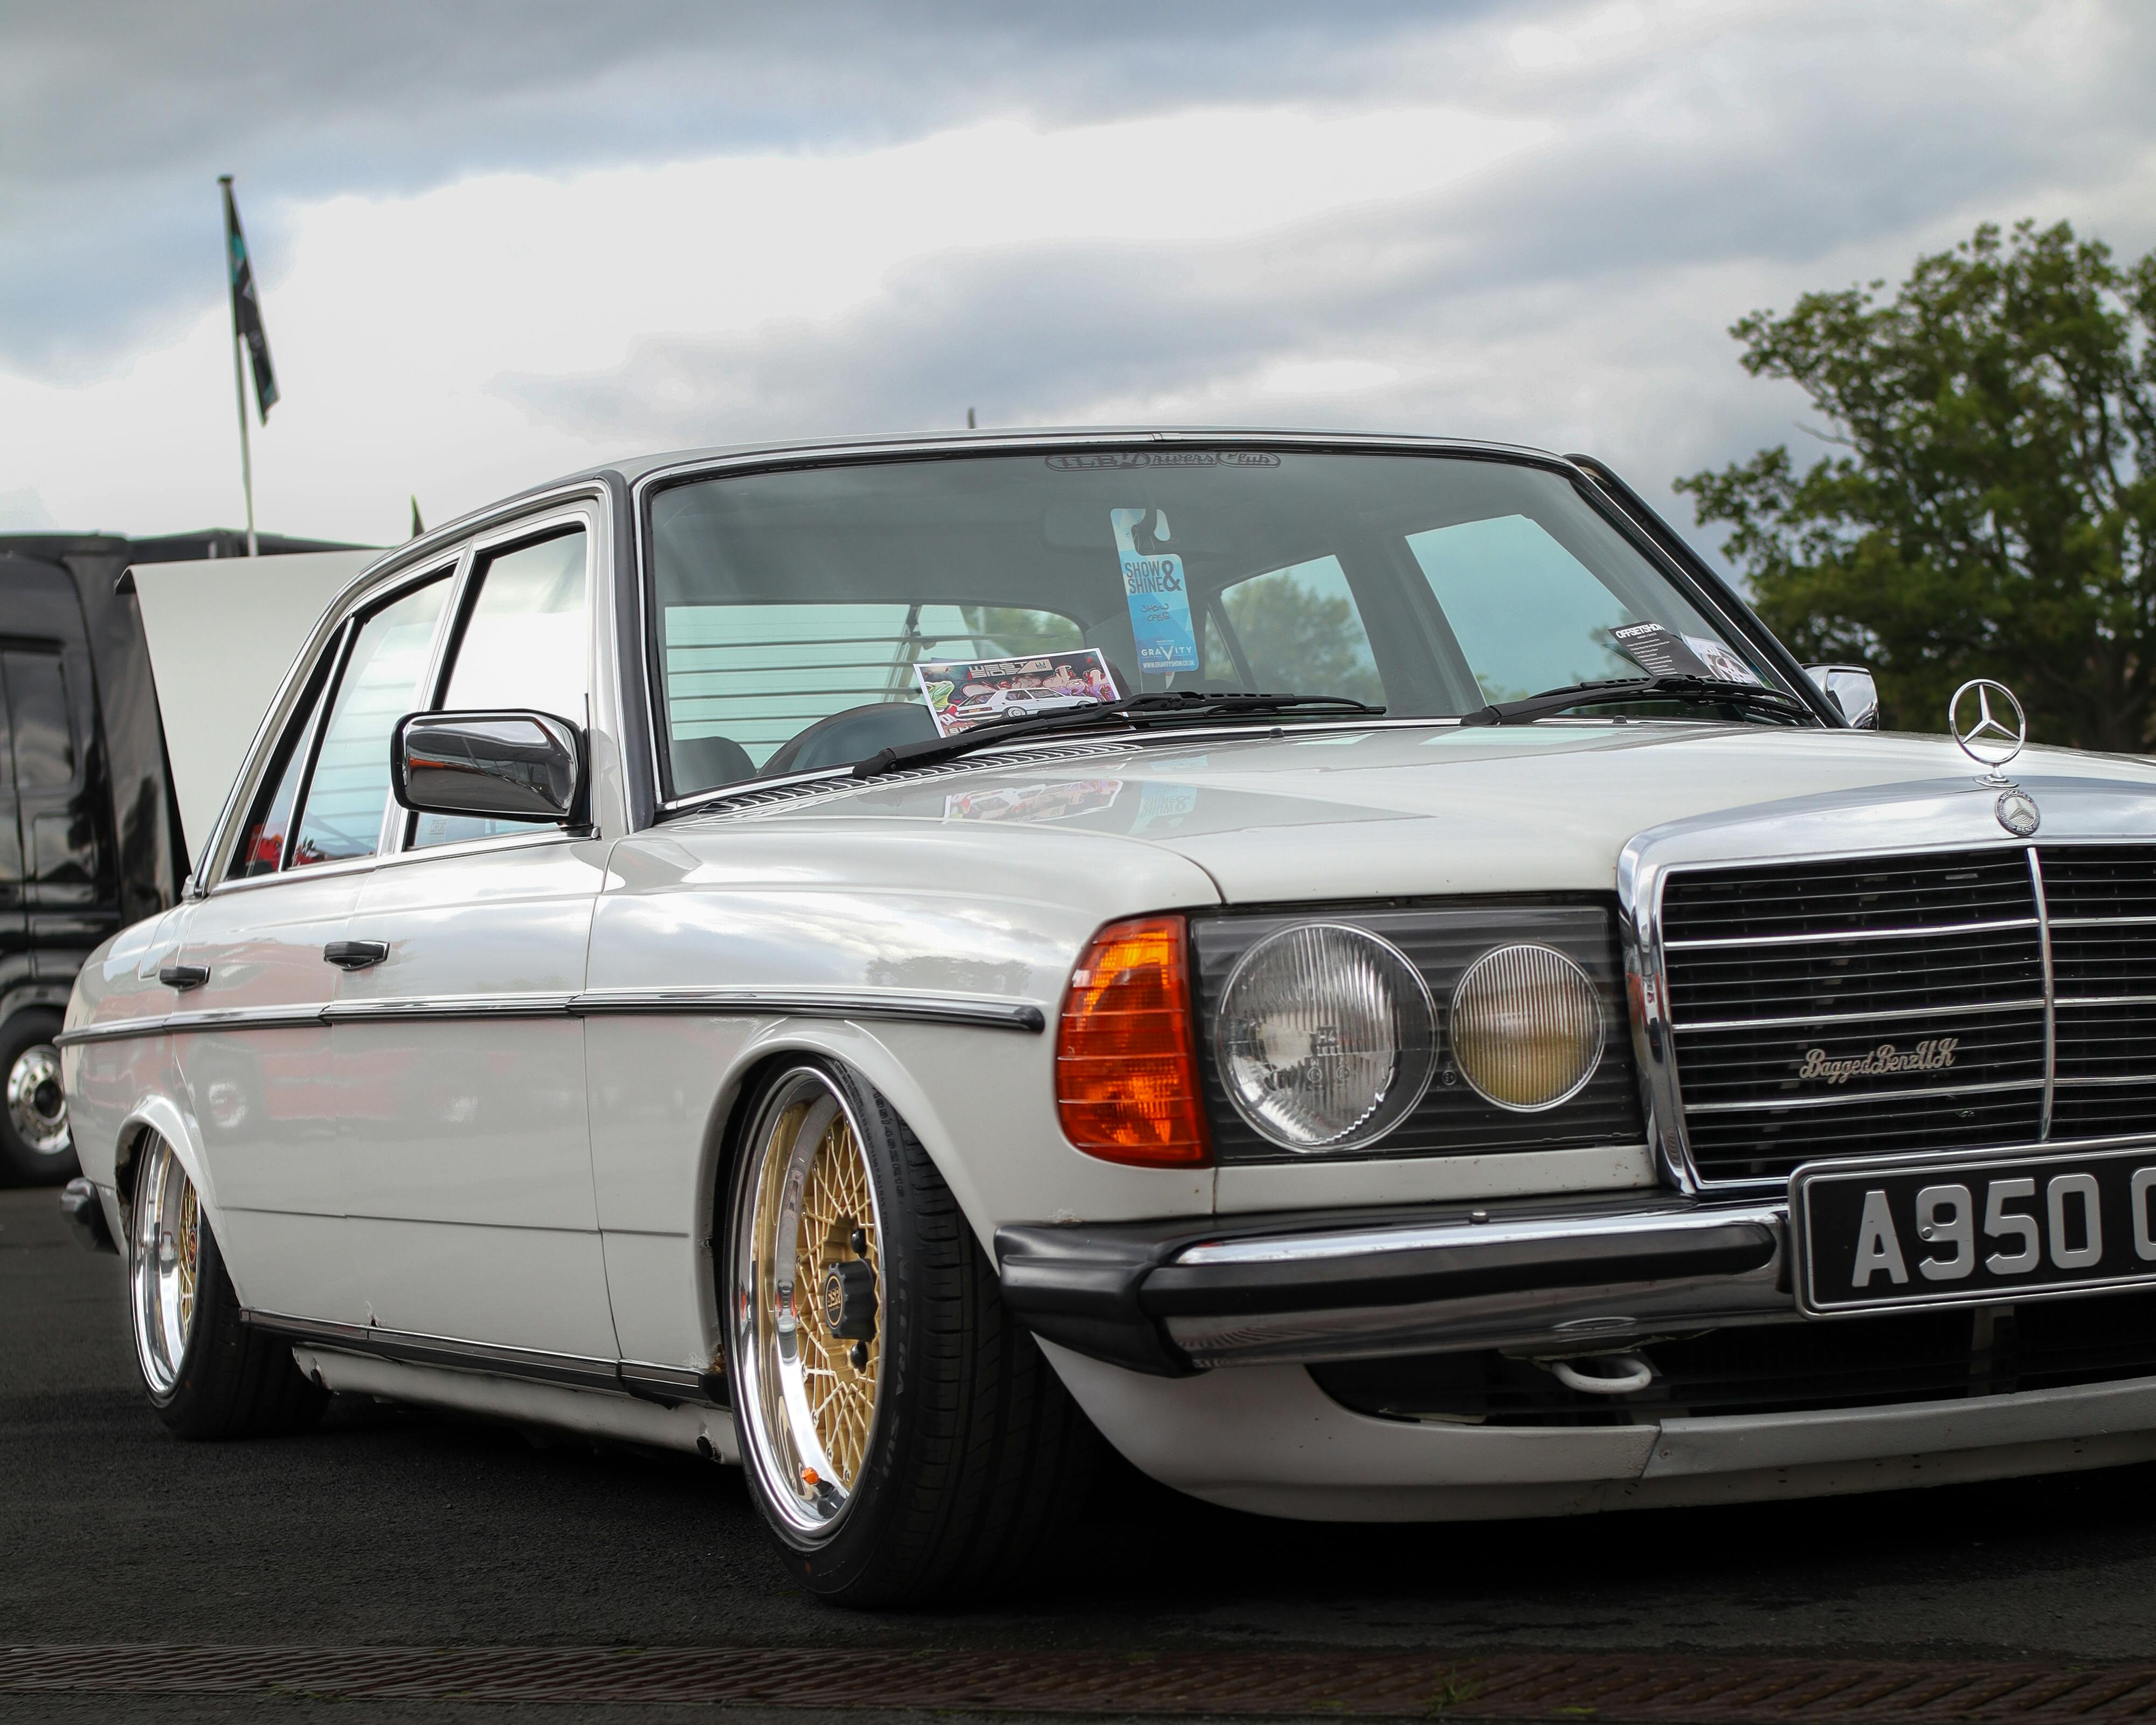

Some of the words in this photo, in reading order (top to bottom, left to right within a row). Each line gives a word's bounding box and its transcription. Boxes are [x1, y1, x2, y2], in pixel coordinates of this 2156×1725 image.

[1124, 561, 1160, 578] SHOW
[1162, 560, 1183, 592] &
[1128, 577, 1165, 594] SHINE
[1141, 603, 1169, 613] SHOW
[1141, 646, 1192, 660] GRAVITY
[1318, 1030, 1336, 1044] H4
[1852, 1172, 2103, 1287] A950
[828, 1287, 841, 1308] SSR
